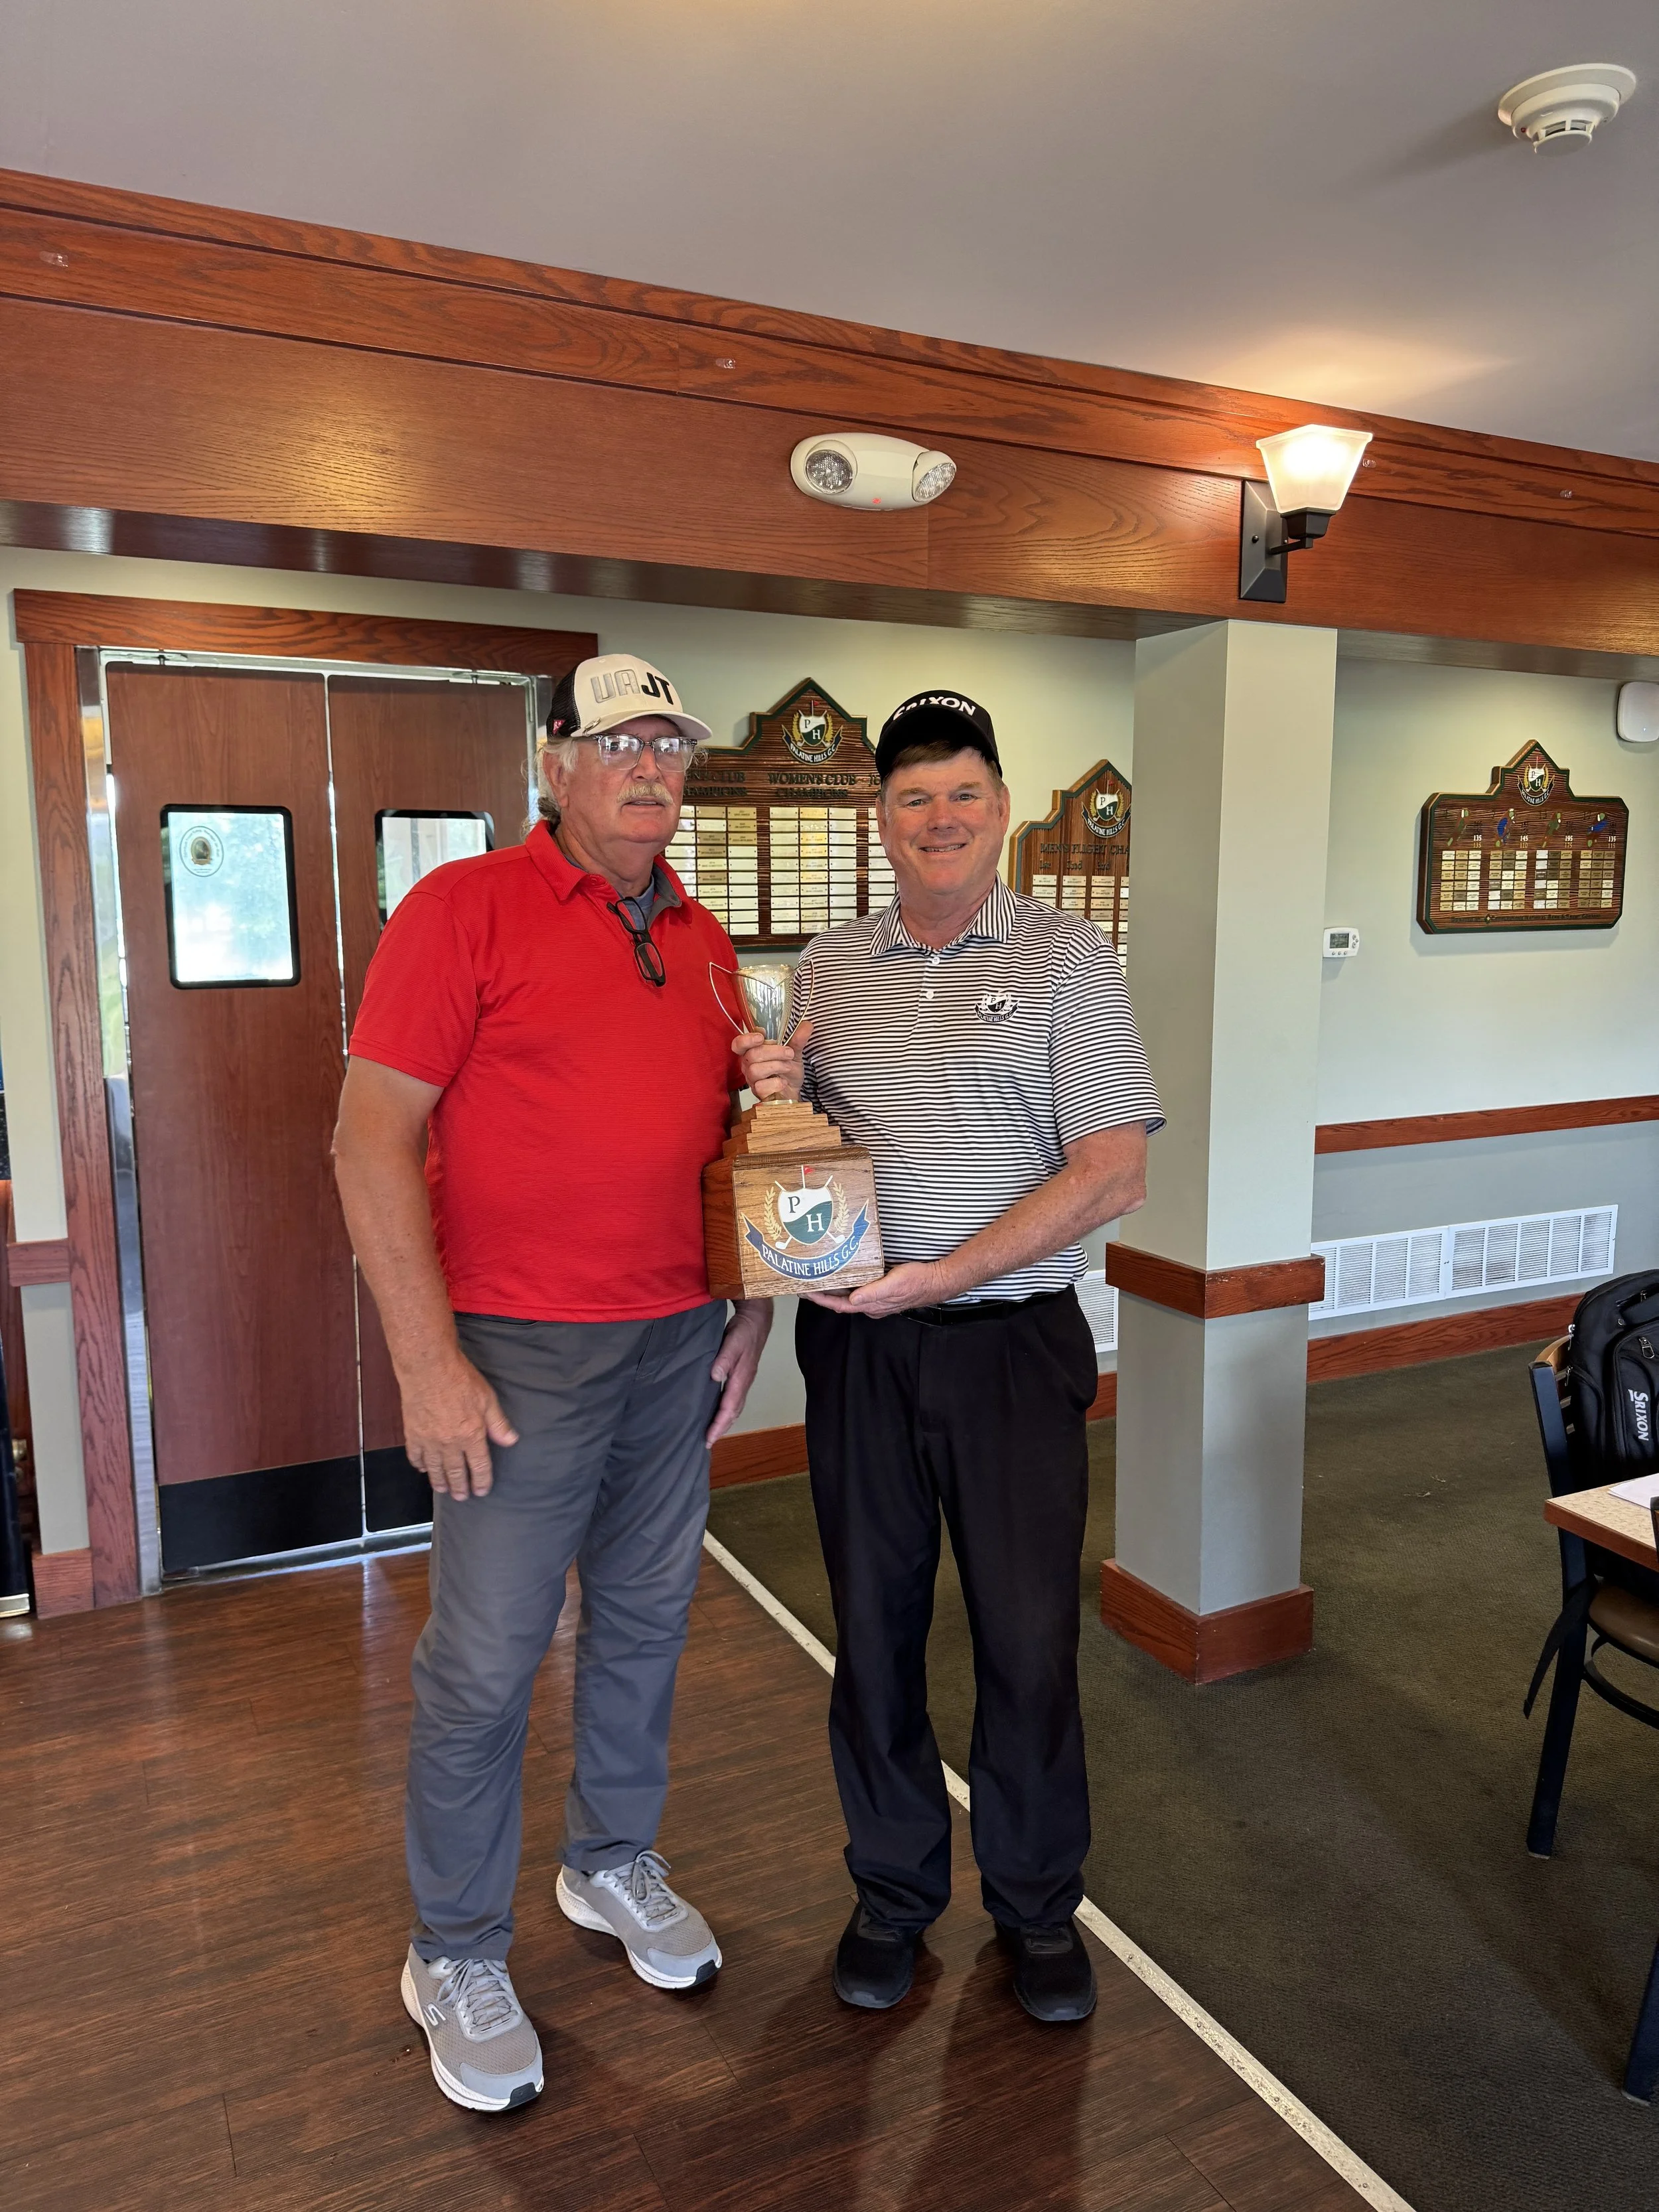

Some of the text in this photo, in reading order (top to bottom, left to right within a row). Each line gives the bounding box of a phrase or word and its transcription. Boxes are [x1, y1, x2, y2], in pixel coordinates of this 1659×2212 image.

[590, 668, 674, 705] UAJT
[804, 719, 810, 729] P
[812, 729, 821, 739] H
[790, 743, 814, 763] PALATINE
[814, 752, 828, 763] HILLS
[767, 773, 823, 784] WOMEN'S
[825, 774, 856, 785] CLUB
[1536, 778, 1541, 787] H
[777, 787, 848, 798] CHAMPIONS
[1100, 796, 1106, 805] P
[1106, 806, 1114, 816] H
[1087, 818, 1106, 836] PALATINE
[1106, 826, 1118, 836] HILLS
[788, 1196, 800, 1213] P
[806, 1213, 825, 1232] H
[761, 1235, 859, 1276] PALATINE HILLS G.C.
[1627, 1388, 1649, 1441] SRIXON
